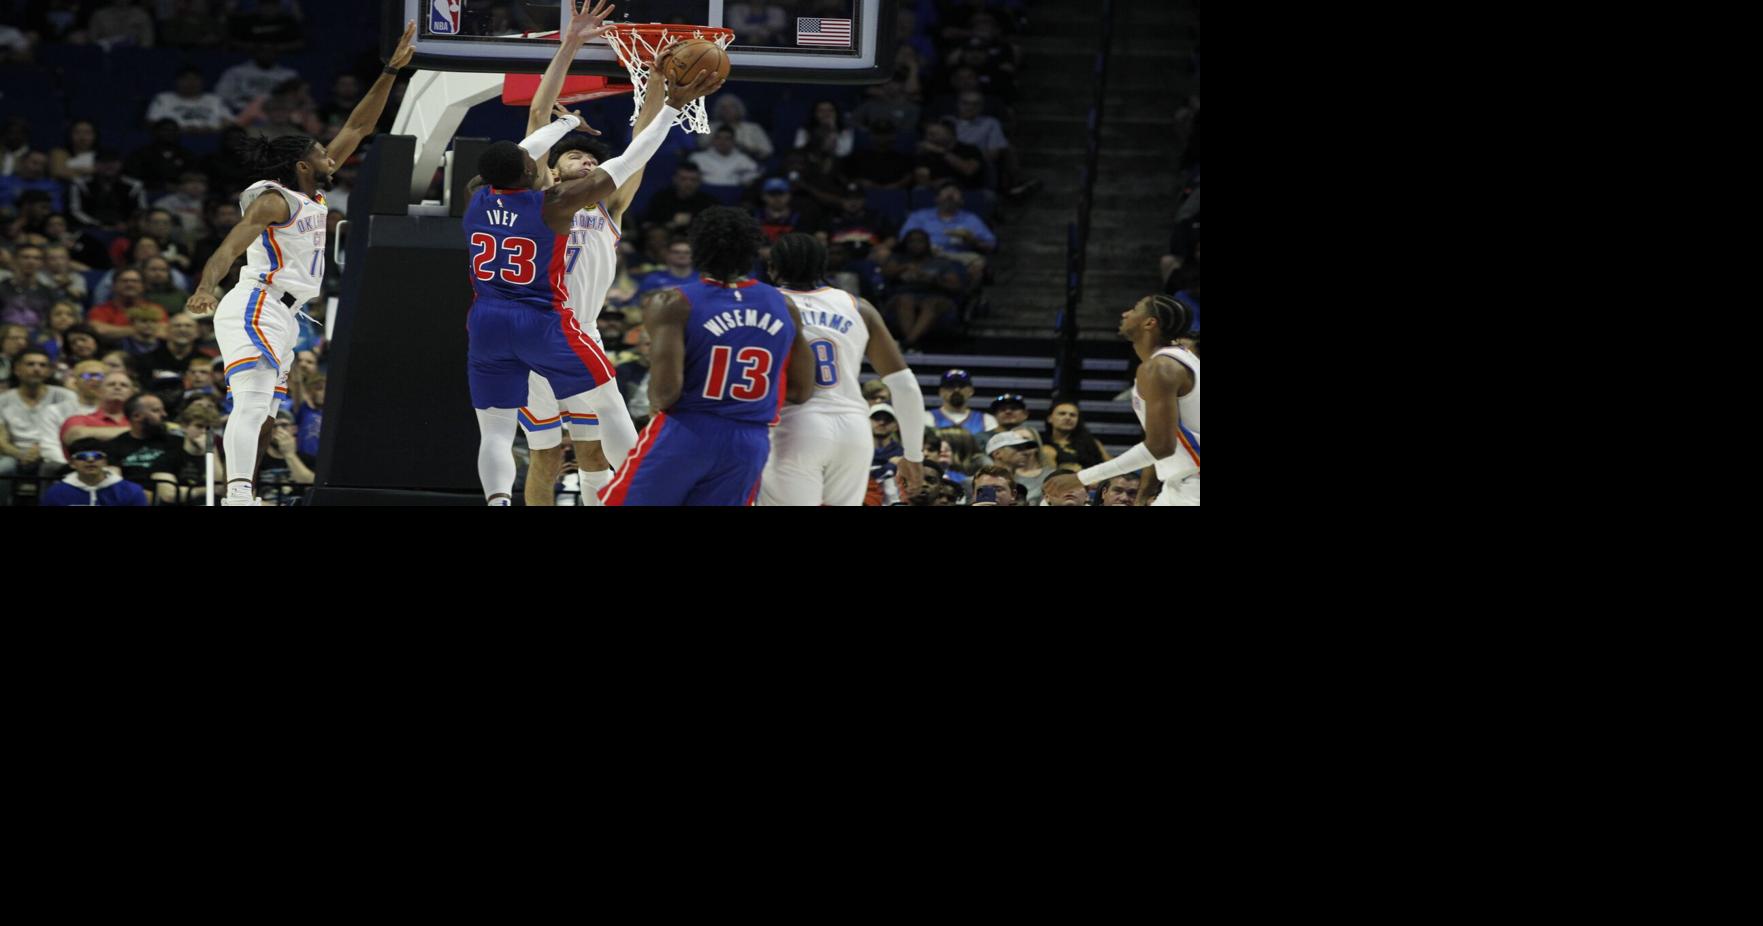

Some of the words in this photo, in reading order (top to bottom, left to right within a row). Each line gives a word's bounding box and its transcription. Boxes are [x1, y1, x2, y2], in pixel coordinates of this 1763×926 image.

[433, 21, 449, 31] NBA
[486, 209, 519, 227] IVEY
[470, 231, 537, 285] 23
[565, 245, 582, 273] 7
[703, 308, 784, 337] WISEMAN
[702, 345, 773, 402] 13
[809, 337, 840, 390] 8
